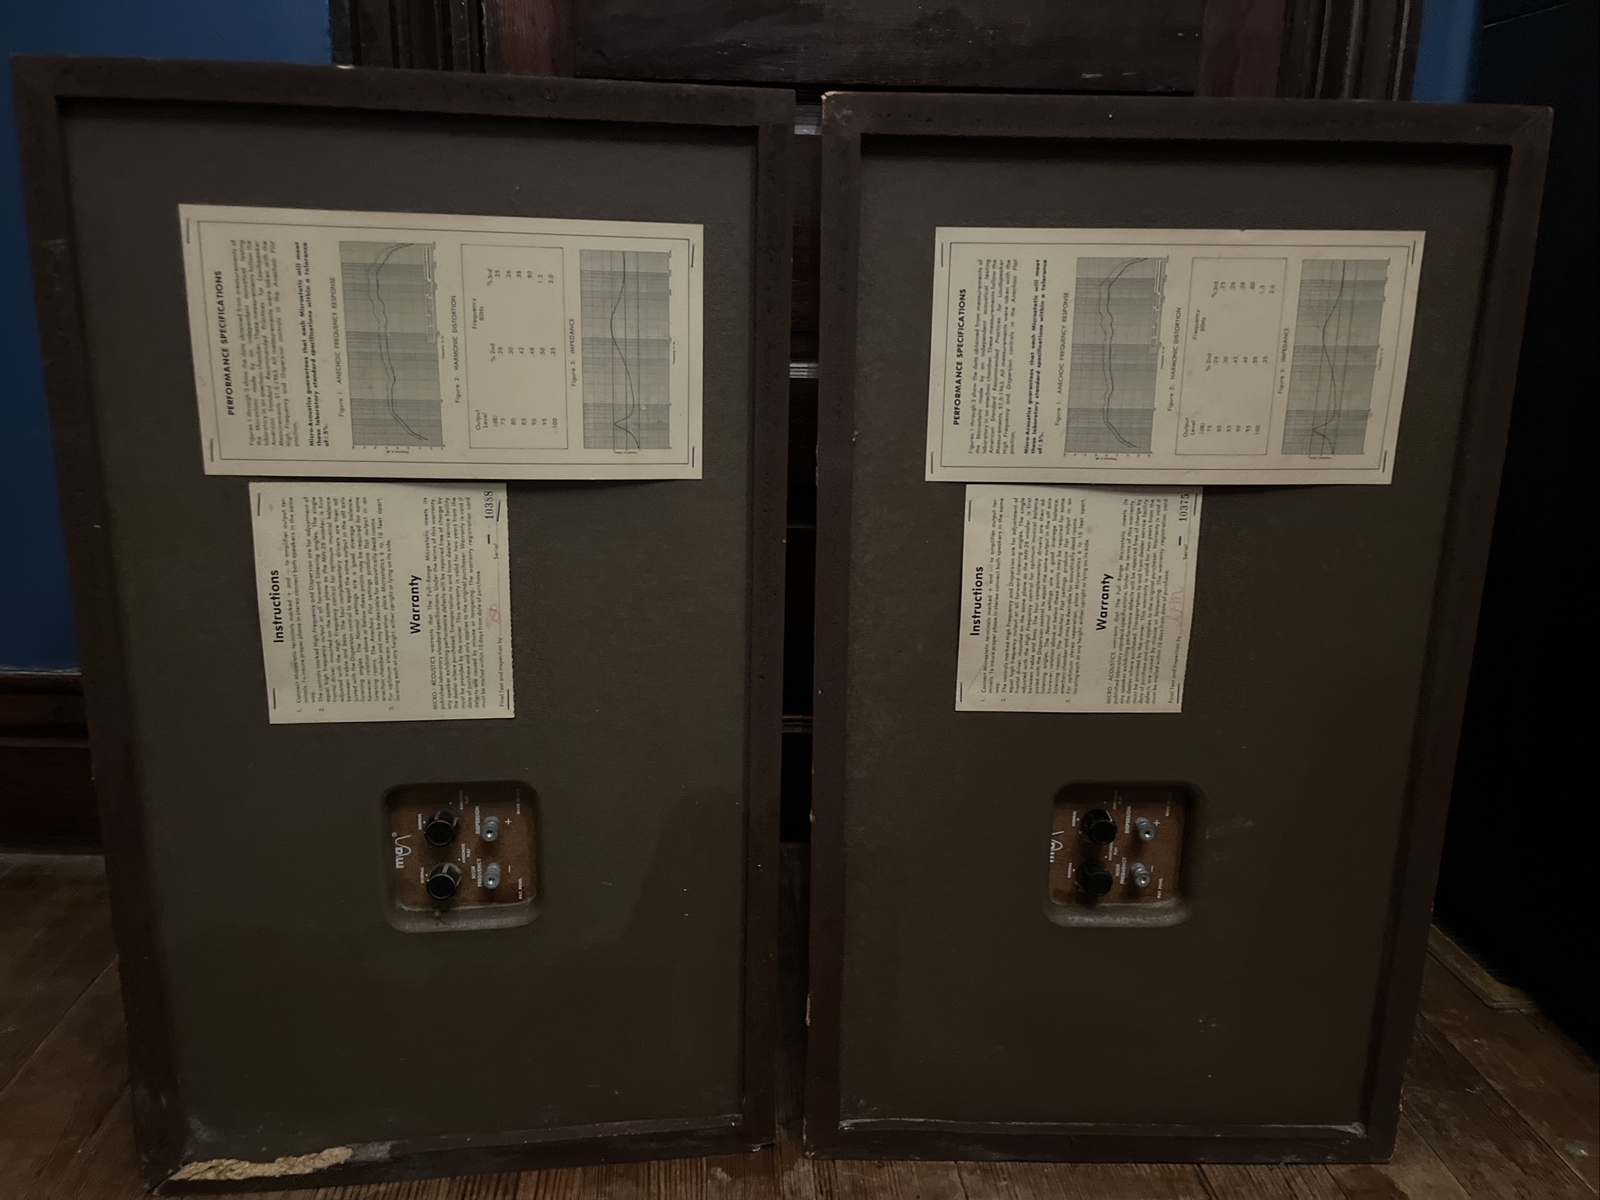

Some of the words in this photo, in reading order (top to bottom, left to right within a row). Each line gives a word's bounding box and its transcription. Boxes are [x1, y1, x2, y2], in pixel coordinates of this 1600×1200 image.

[214, 271, 228, 344] SPECIFICATIONS
[297, 279, 305, 317] Microstatic
[329, 277, 338, 309] RESPONSE
[1061, 292, 1069, 323] RESPONSE
[331, 311, 340, 349] FREQUENCY
[450, 295, 458, 333] DISTORTION
[956, 289, 966, 358] SPECIFICATIONS
[1173, 307, 1182, 344] DISTORTION
[1192, 309, 1201, 340] Frequency
[307, 310, 317, 356] specifications
[1059, 325, 1067, 361] FREQUENCY
[304, 356, 313, 395] guarantees
[310, 358, 318, 388] standard
[334, 351, 342, 384] ANECHOIC
[570, 367, 578, 387] Figure
[1023, 407, 1032, 454] Micro-Acoustics
[1031, 295, 1039, 331] Microstatic
[1057, 363, 1065, 395] ANECHOIC
[1170, 346, 1179, 380] HARMONIC
[1277, 375, 1285, 394] Figure
[1281, 327, 1290, 363] IMPEDANCE
[221, 348, 235, 416] PERFORMANCE
[454, 384, 462, 404] Figure
[953, 361, 963, 425] PERFORMANCE
[1031, 401, 1040, 435] laboratory
[1036, 324, 1044, 368] specifications
[306, 396, 315, 447] Micro-Acoustics
[1054, 407, 1062, 426] Figure
[1182, 417, 1190, 438] Output
[482, 490, 494, 519] 10388
[1178, 493, 1191, 521] 10375
[268, 570, 285, 643] Instructions
[408, 575, 422, 634] Warranty
[969, 566, 984, 636] Instructions
[1095, 573, 1114, 631] Warranty
[429, 655, 437, 687] ACOUSTICS
[1172, 643, 1181, 669] Inspection
